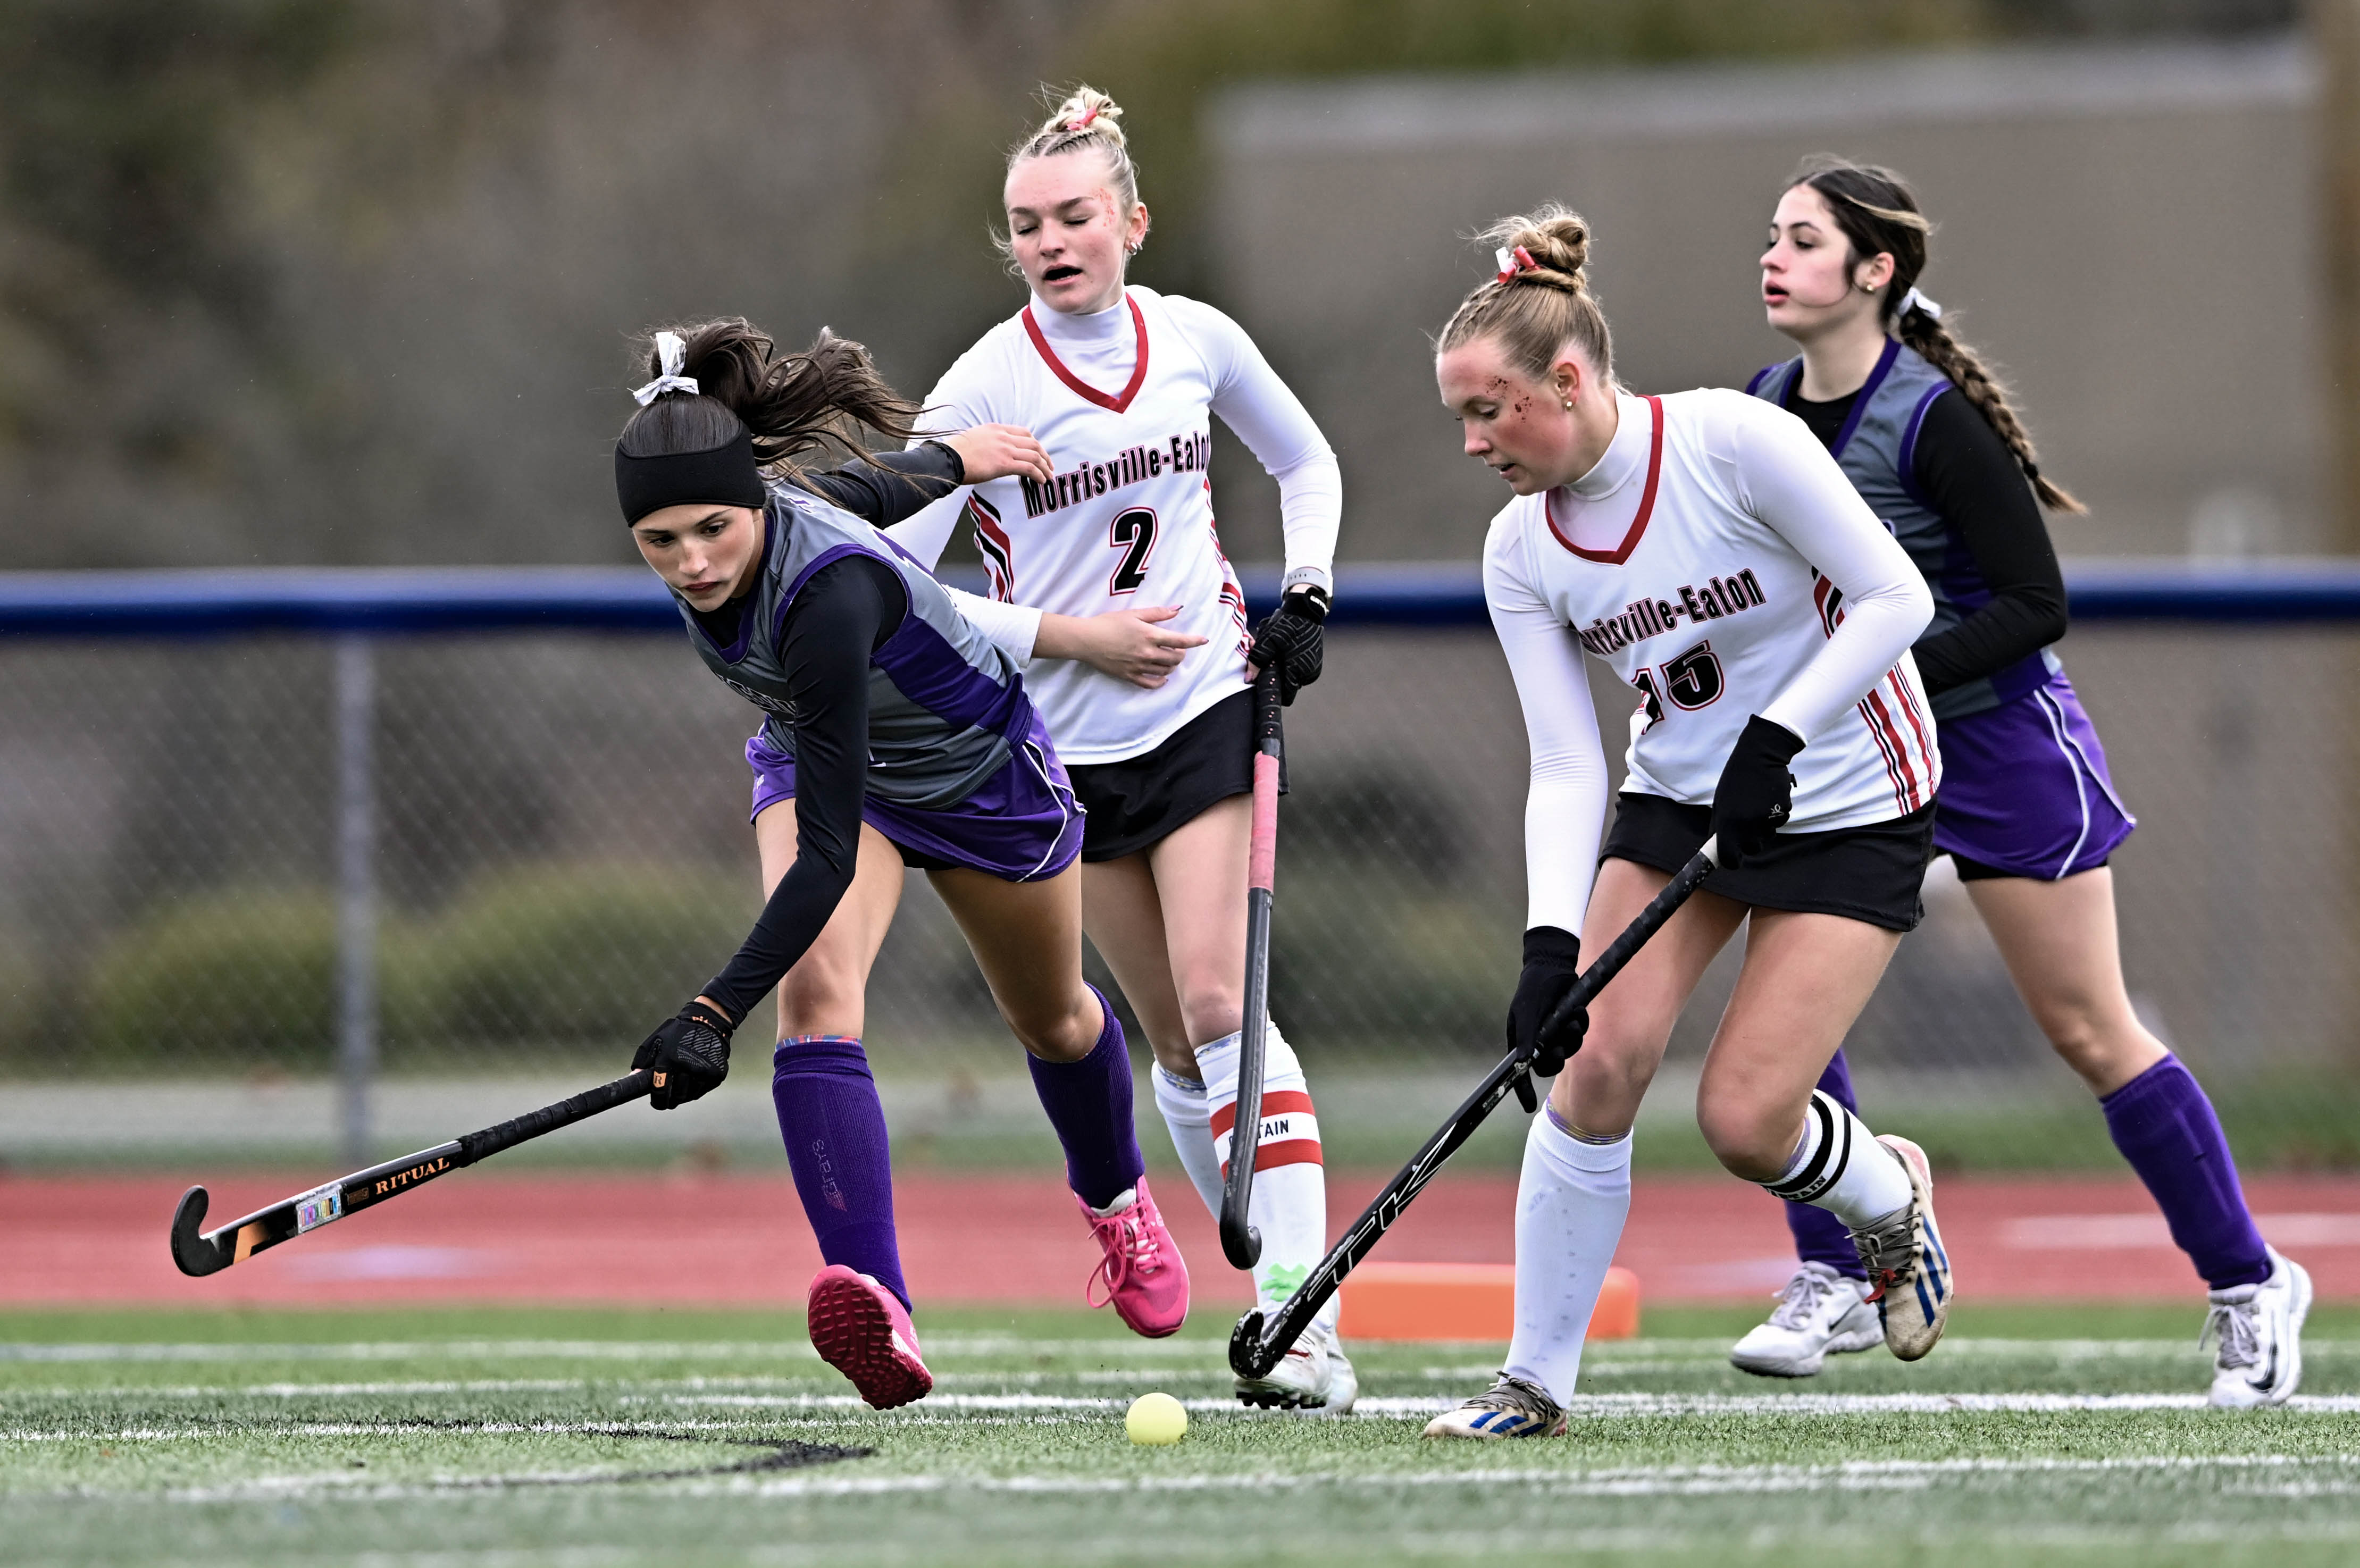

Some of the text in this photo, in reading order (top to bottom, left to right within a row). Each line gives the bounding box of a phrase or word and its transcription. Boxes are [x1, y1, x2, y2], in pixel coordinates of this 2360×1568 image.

[1018, 431, 1209, 519] Morrisville-Eato
[1110, 506, 1158, 597] 2
[1631, 640, 1724, 735] 15
[375, 1157, 450, 1195] RITUAL
